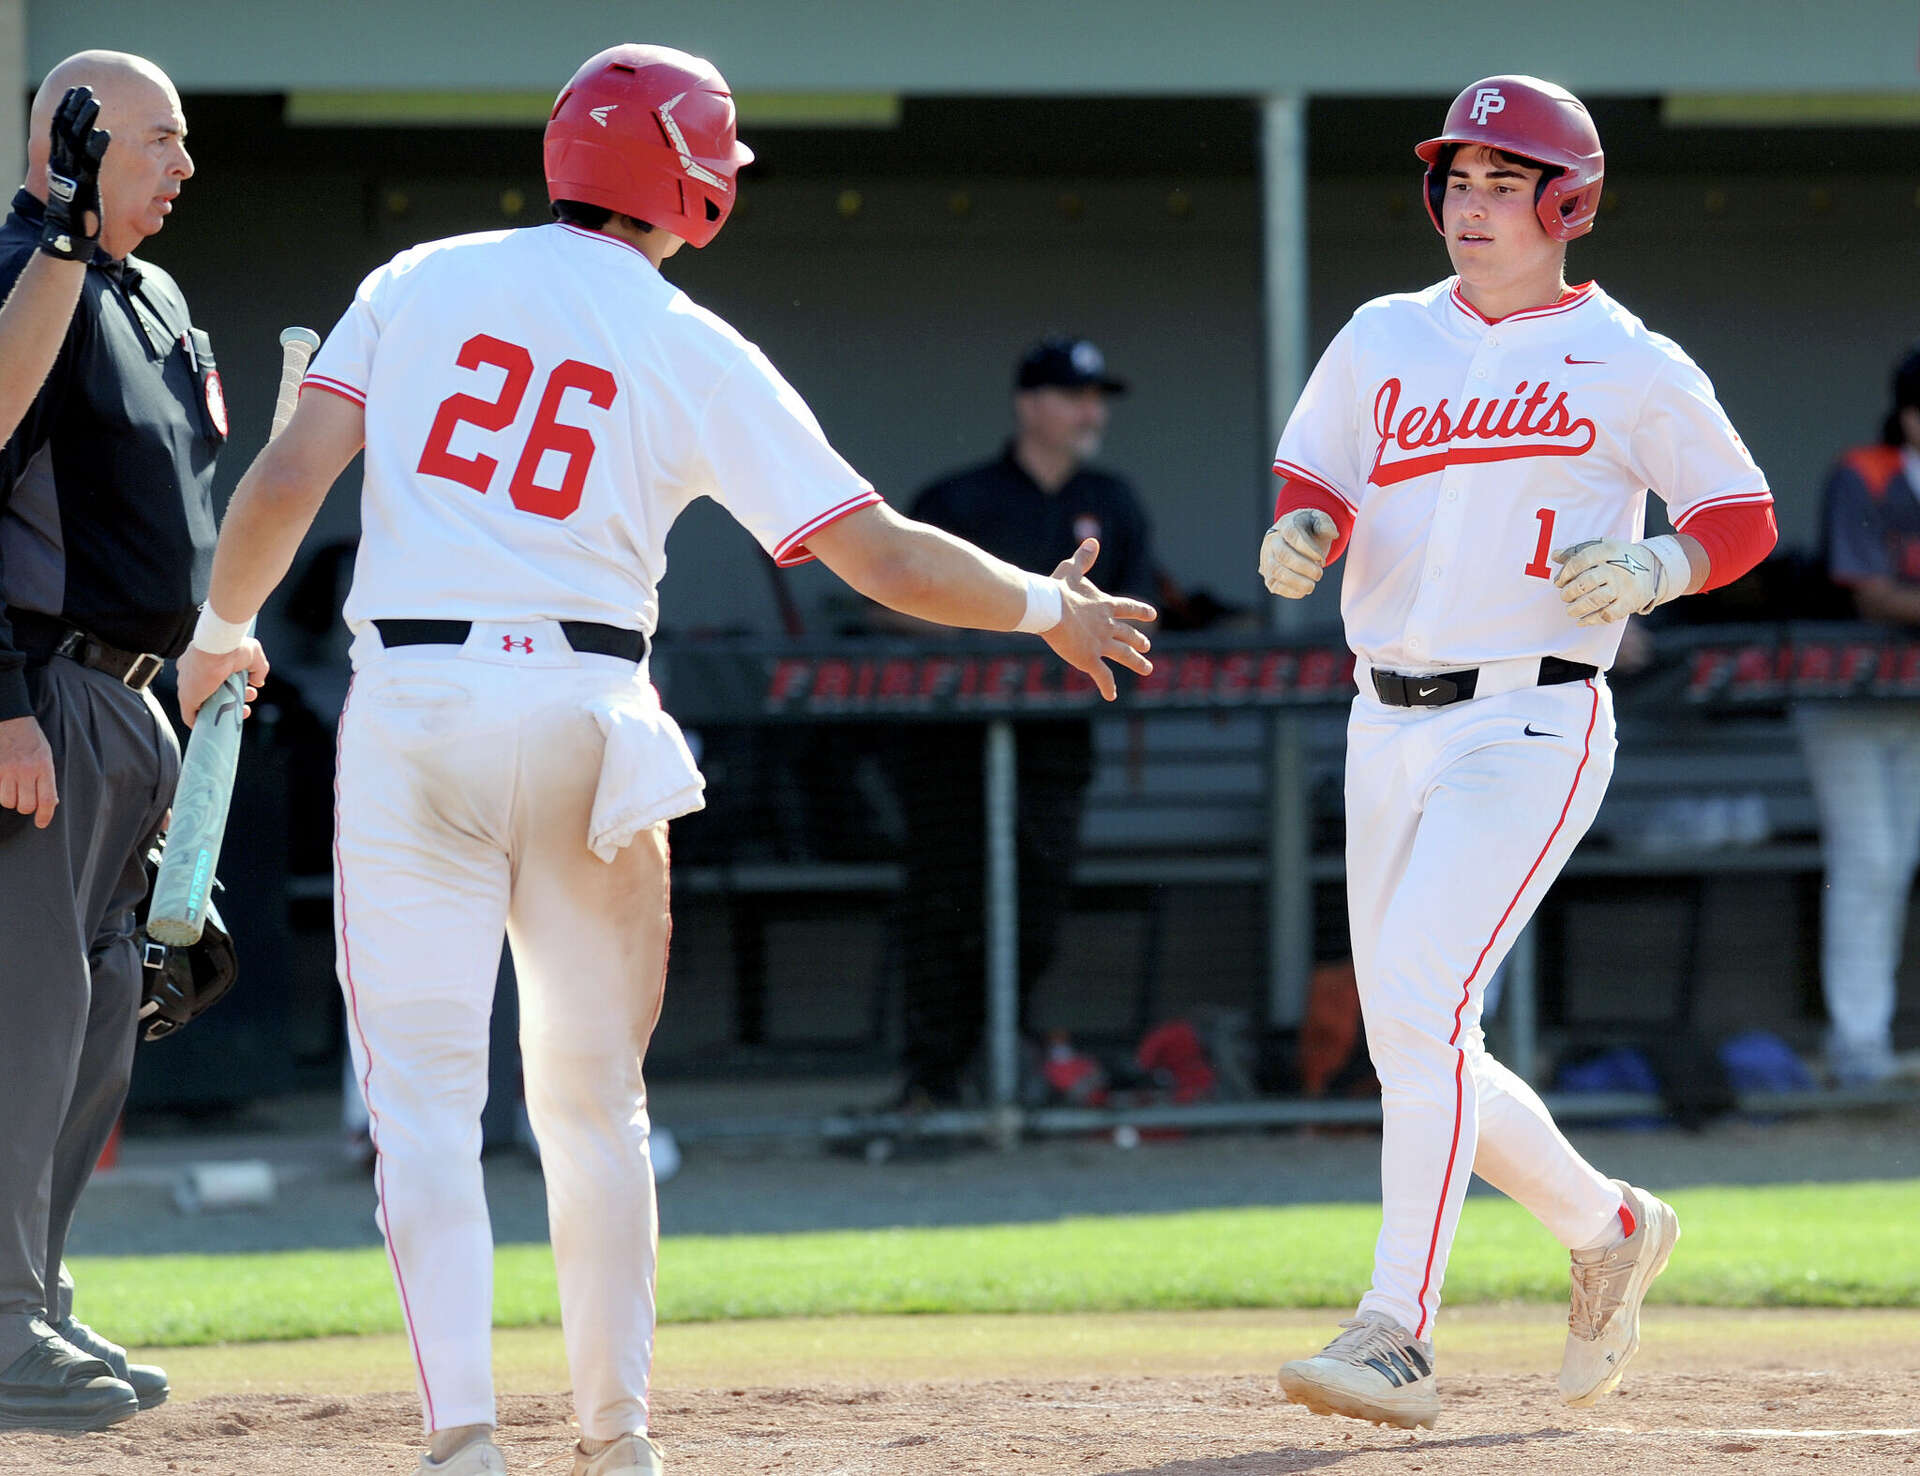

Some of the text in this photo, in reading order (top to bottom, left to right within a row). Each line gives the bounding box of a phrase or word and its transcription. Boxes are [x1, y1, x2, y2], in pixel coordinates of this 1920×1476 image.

[1469, 88, 1506, 126] FP
[415, 332, 619, 521] 26
[1370, 377, 1590, 466] Jesuits
[1524, 506, 1557, 580] 1
